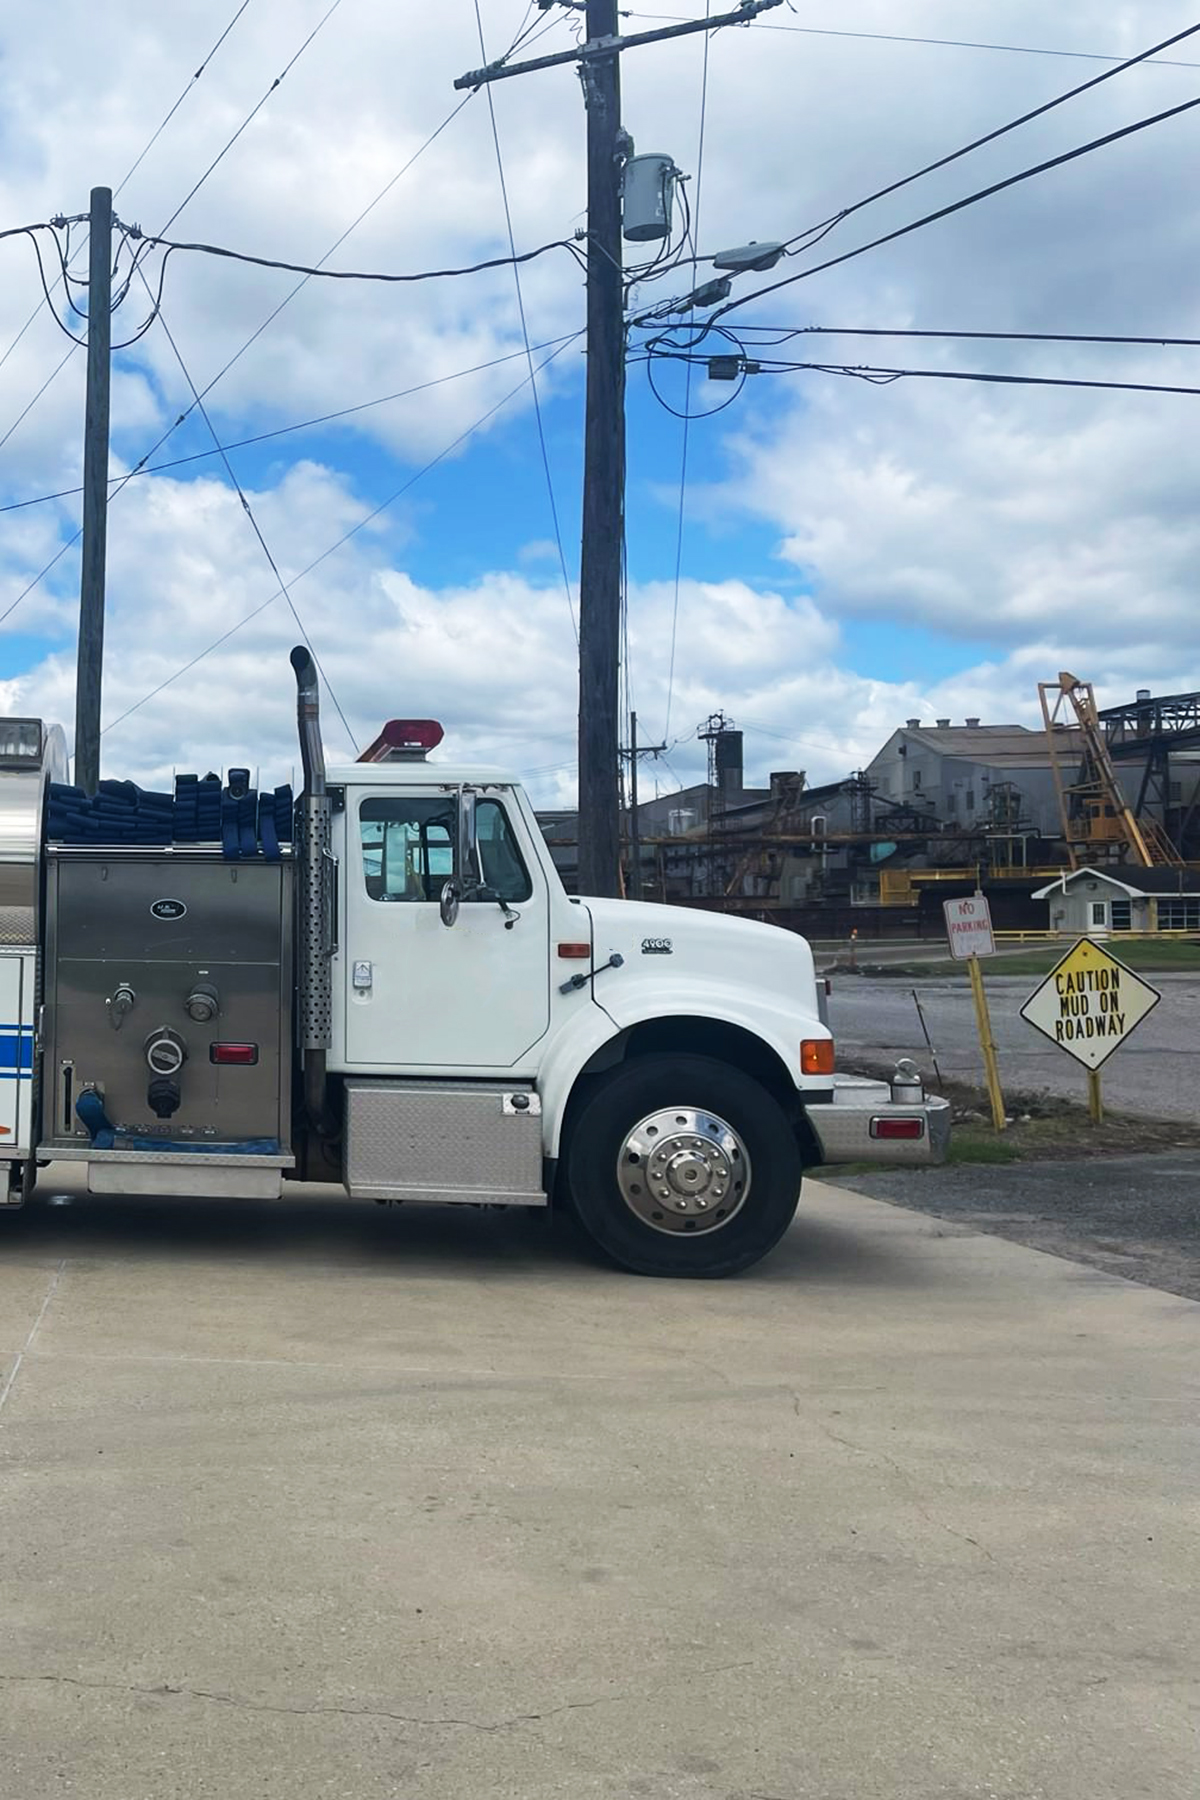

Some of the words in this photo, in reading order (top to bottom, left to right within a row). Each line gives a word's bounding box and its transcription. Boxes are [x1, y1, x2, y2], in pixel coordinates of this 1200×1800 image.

[958, 903, 975, 915] NO
[951, 919, 989, 933] PARKING
[1055, 967, 1120, 995] CAUTION
[1060, 994, 1089, 1018] MUD
[1099, 991, 1119, 1014] ON
[1055, 1013, 1125, 1041] ROADWAY
